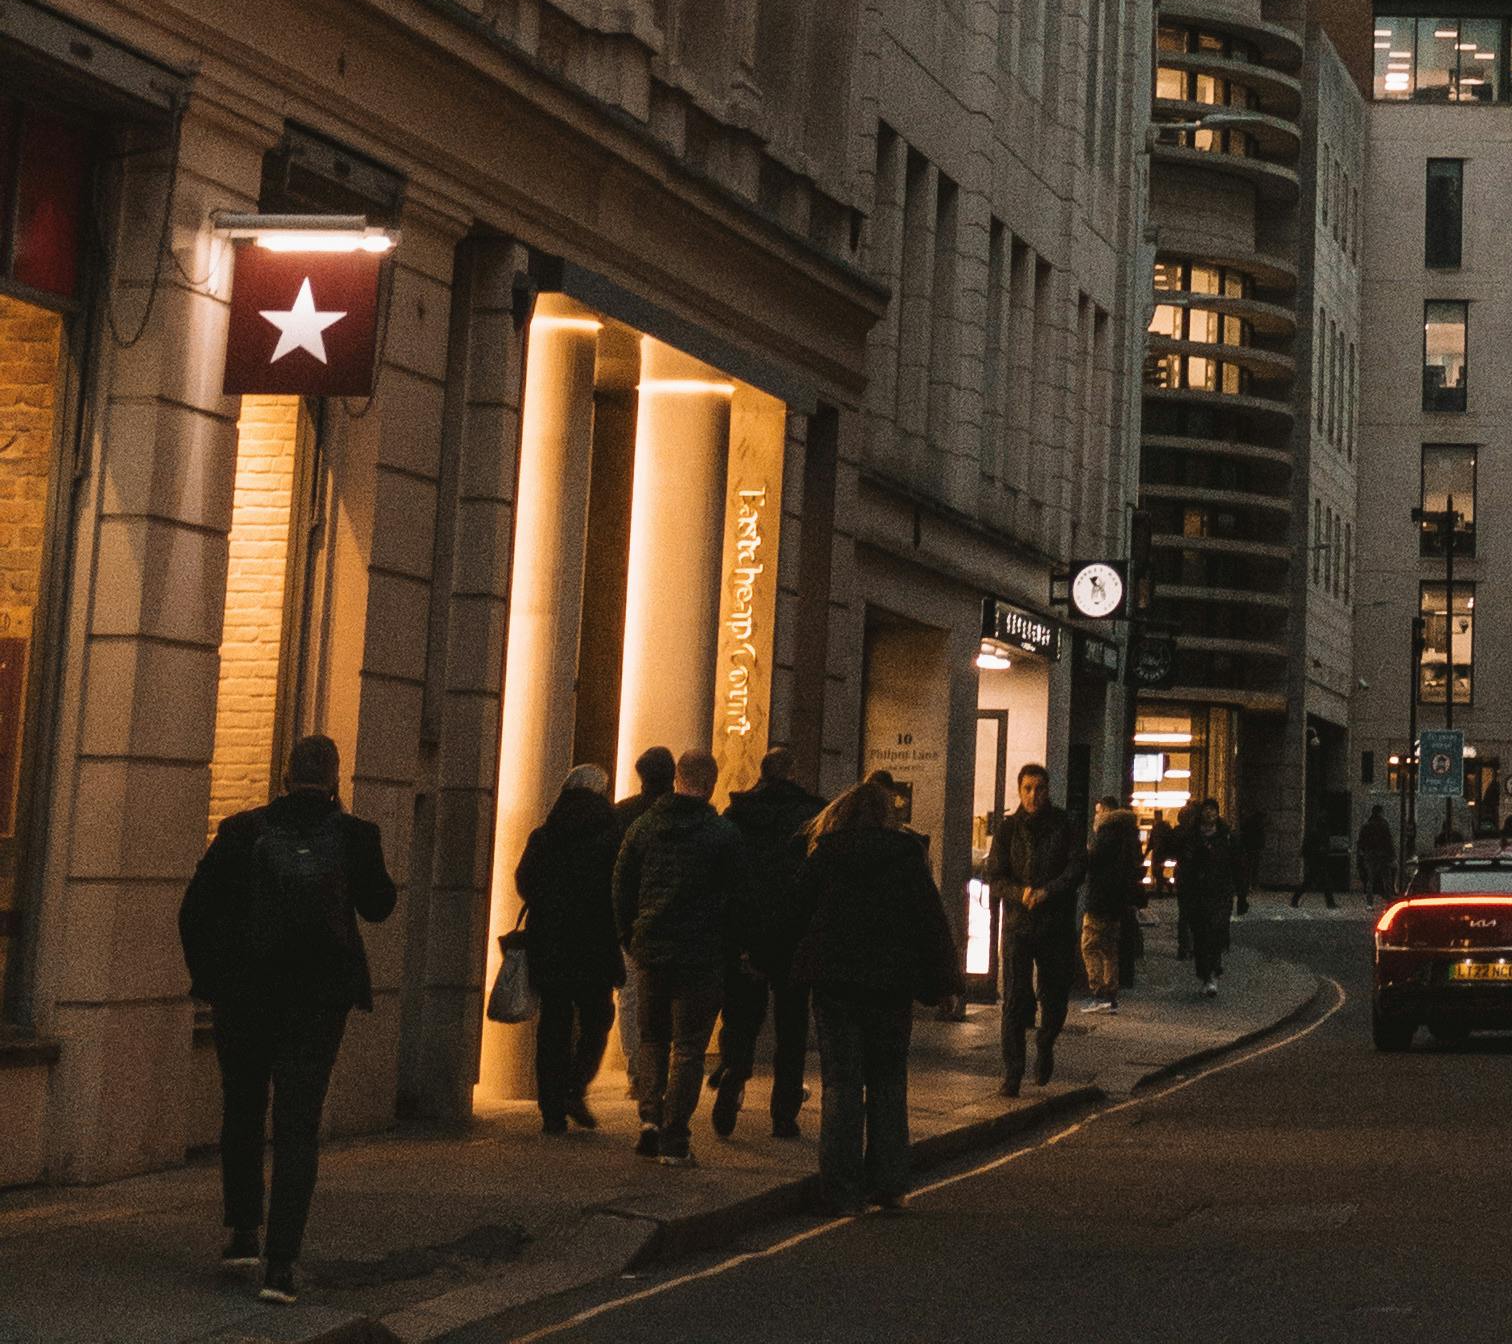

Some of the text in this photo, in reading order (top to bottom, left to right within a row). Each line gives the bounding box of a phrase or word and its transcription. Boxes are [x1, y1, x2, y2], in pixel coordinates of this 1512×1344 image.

[725, 486, 766, 737] Eastcheap Court
[896, 733, 912, 745] 10
